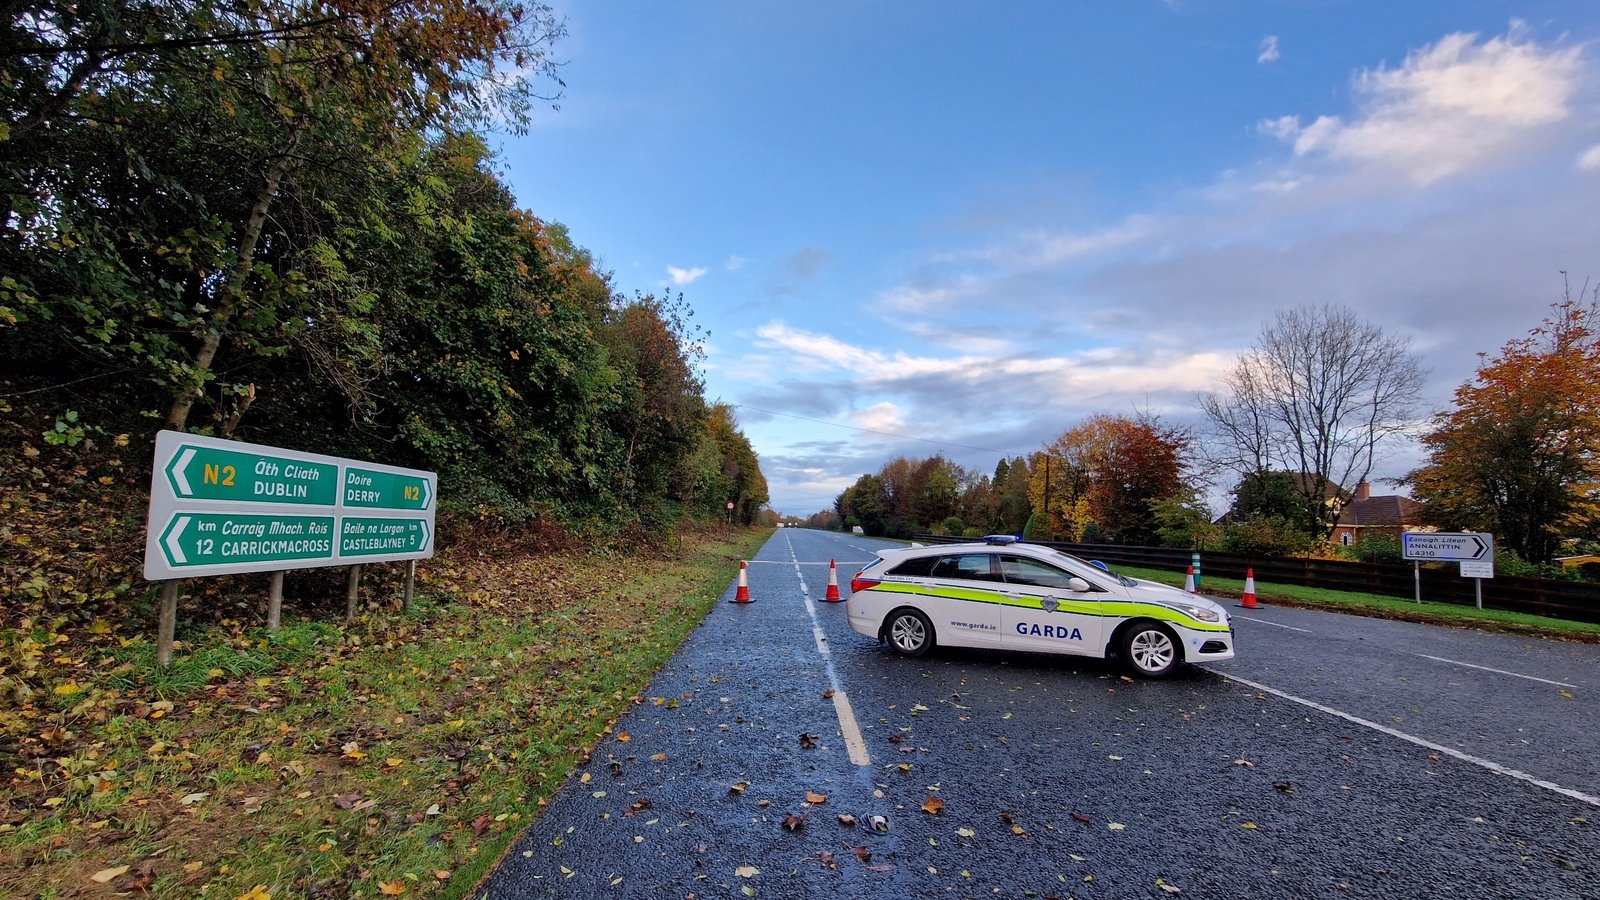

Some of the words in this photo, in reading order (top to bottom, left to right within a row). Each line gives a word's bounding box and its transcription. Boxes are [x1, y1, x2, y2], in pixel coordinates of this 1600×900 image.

[203, 463, 236, 487] N2
[284, 464, 320, 481] Cliath
[348, 472, 372, 486] Doire
[254, 481, 307, 498] DUBLIN
[348, 489, 380, 502] DERRY
[404, 486, 420, 500] N2
[198, 520, 216, 532] km
[222, 520, 265, 538] Carraig
[308, 522, 328, 534] Rois
[344, 522, 365, 534] Baile
[367, 526, 378, 534] na
[380, 524, 404, 536] Lorgan
[196, 538, 214, 555] 12
[343, 538, 406, 550] CASTLEBLAYNEY
[410, 534, 416, 545] 5
[222, 539, 330, 556] CARRICKMACROSS
[950, 620, 997, 631] www.garda.ie
[1016, 622, 1083, 640] GARDA
